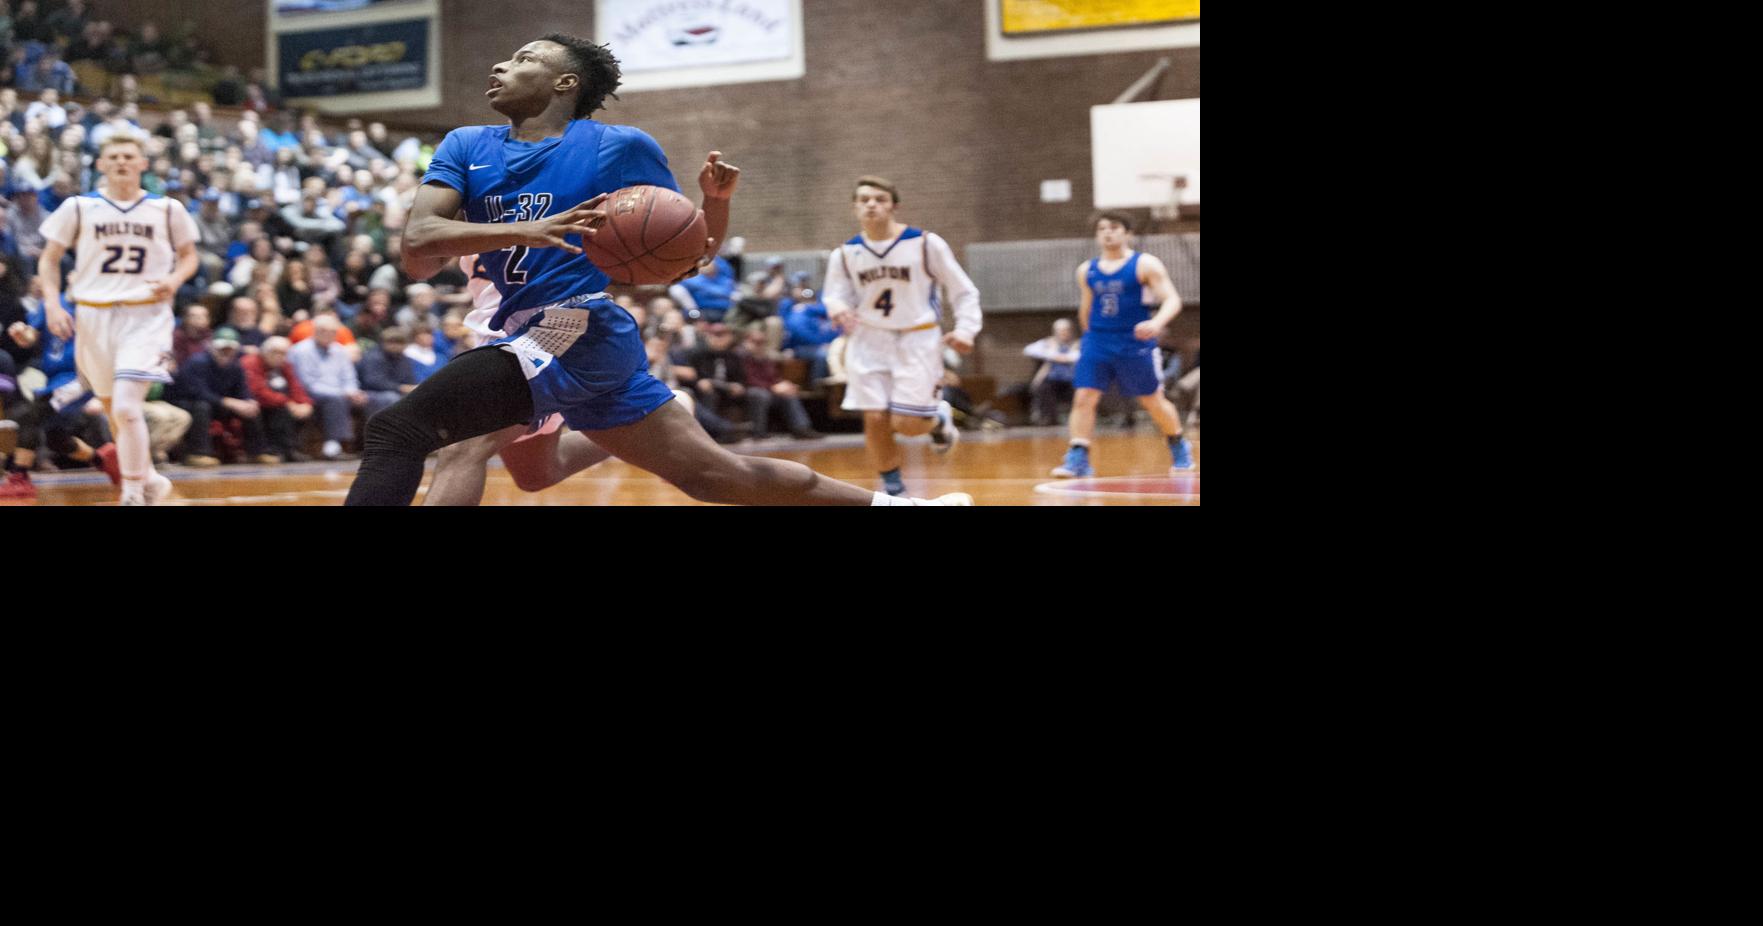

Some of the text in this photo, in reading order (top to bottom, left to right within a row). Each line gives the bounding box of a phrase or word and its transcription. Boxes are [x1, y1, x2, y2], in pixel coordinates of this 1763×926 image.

[485, 193, 553, 223] U-32
[95, 222, 154, 240] MILTON
[101, 245, 147, 274] 23
[501, 245, 530, 284] 2
[858, 266, 911, 287] MILTON
[874, 288, 895, 317] 4
